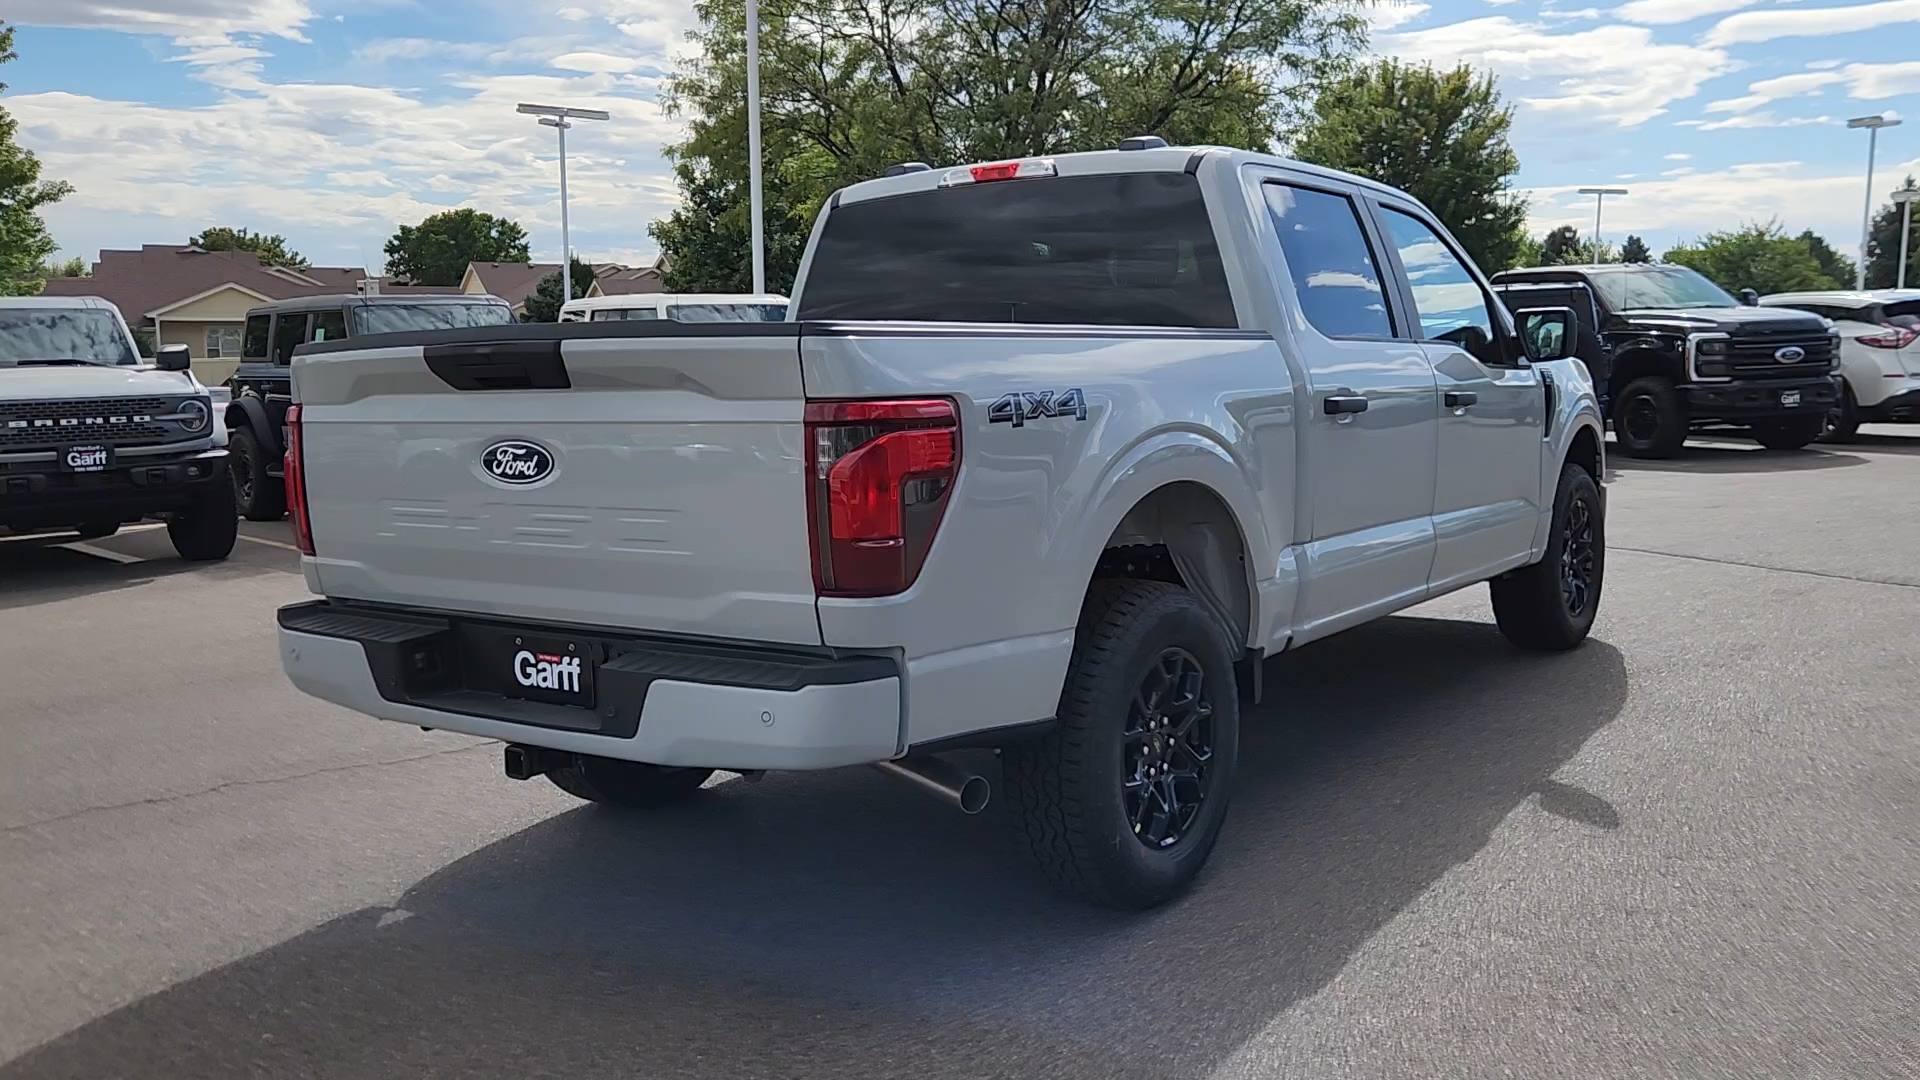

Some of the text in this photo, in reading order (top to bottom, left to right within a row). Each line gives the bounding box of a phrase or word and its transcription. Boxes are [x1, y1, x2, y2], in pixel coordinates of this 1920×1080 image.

[8, 415, 151, 428] BRONCO
[67, 451, 107, 466] Garff
[492, 446, 539, 476] Ford
[514, 650, 581, 693] Garff
